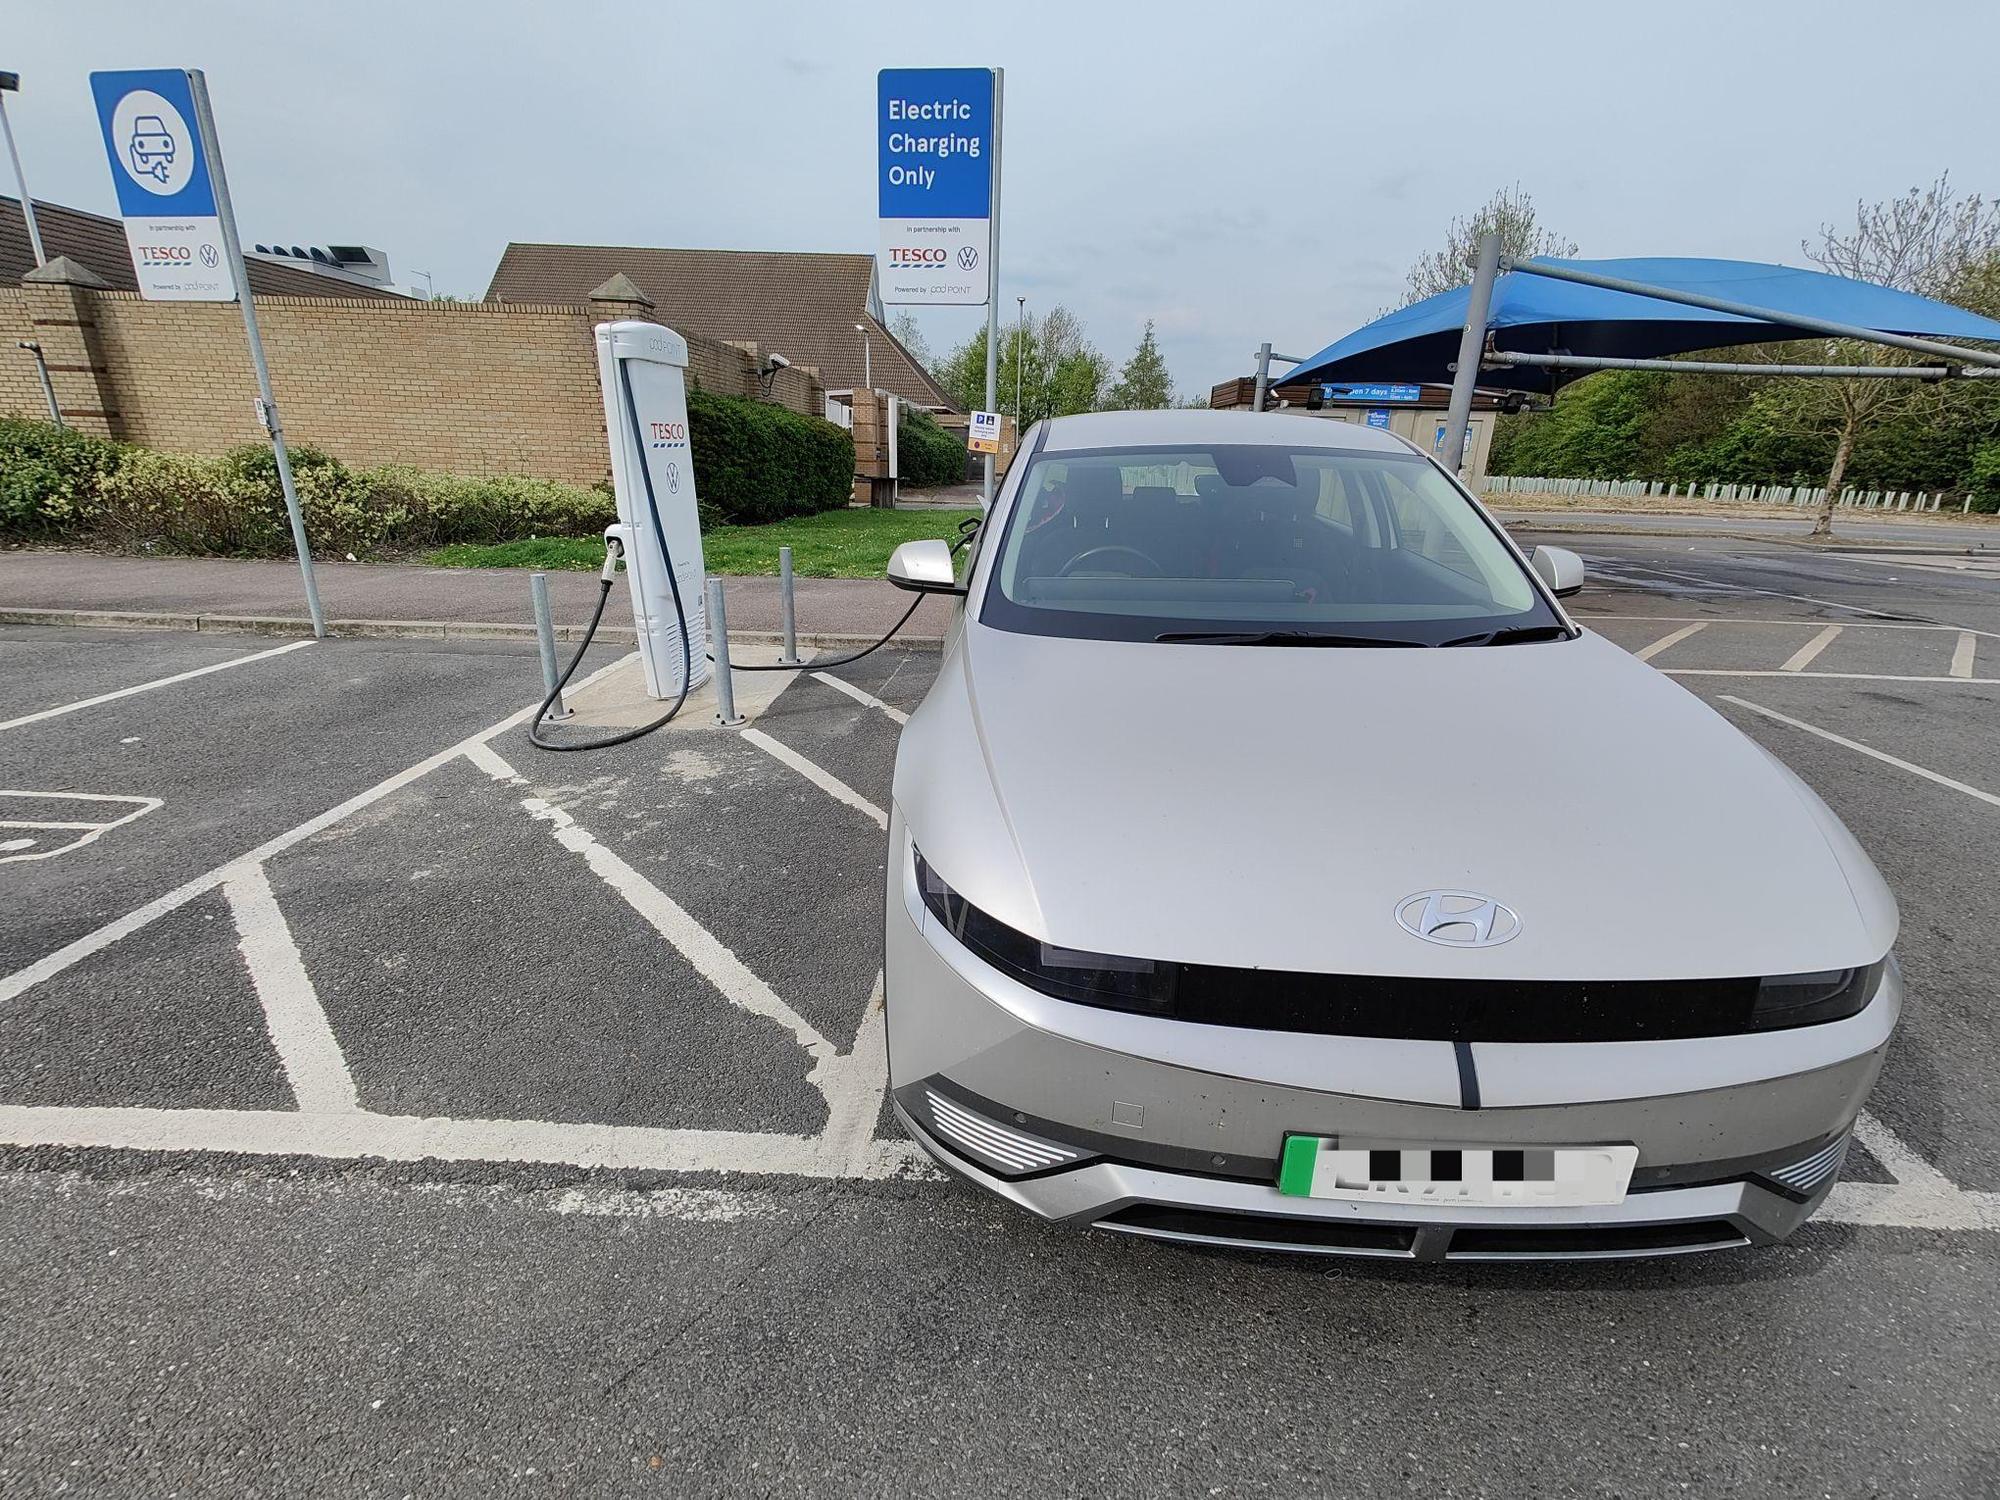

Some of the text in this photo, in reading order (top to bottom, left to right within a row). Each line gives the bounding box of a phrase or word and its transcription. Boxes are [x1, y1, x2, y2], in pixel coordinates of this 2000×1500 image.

[888, 99, 971, 120] Electric
[888, 132, 980, 158] Charging
[888, 165, 936, 190] Only
[913, 226, 947, 234] partnership
[138, 246, 191, 260] TESCO
[889, 248, 948, 262] TESCO
[152, 283, 174, 291] Powered
[174, 283, 181, 291] by
[894, 286, 919, 294] Powered
[920, 286, 927, 294] by
[947, 286, 972, 294] POINT
[1365, 387, 1370, 395] 7
[1371, 387, 1388, 397] days
[650, 422, 685, 440] TESCO
